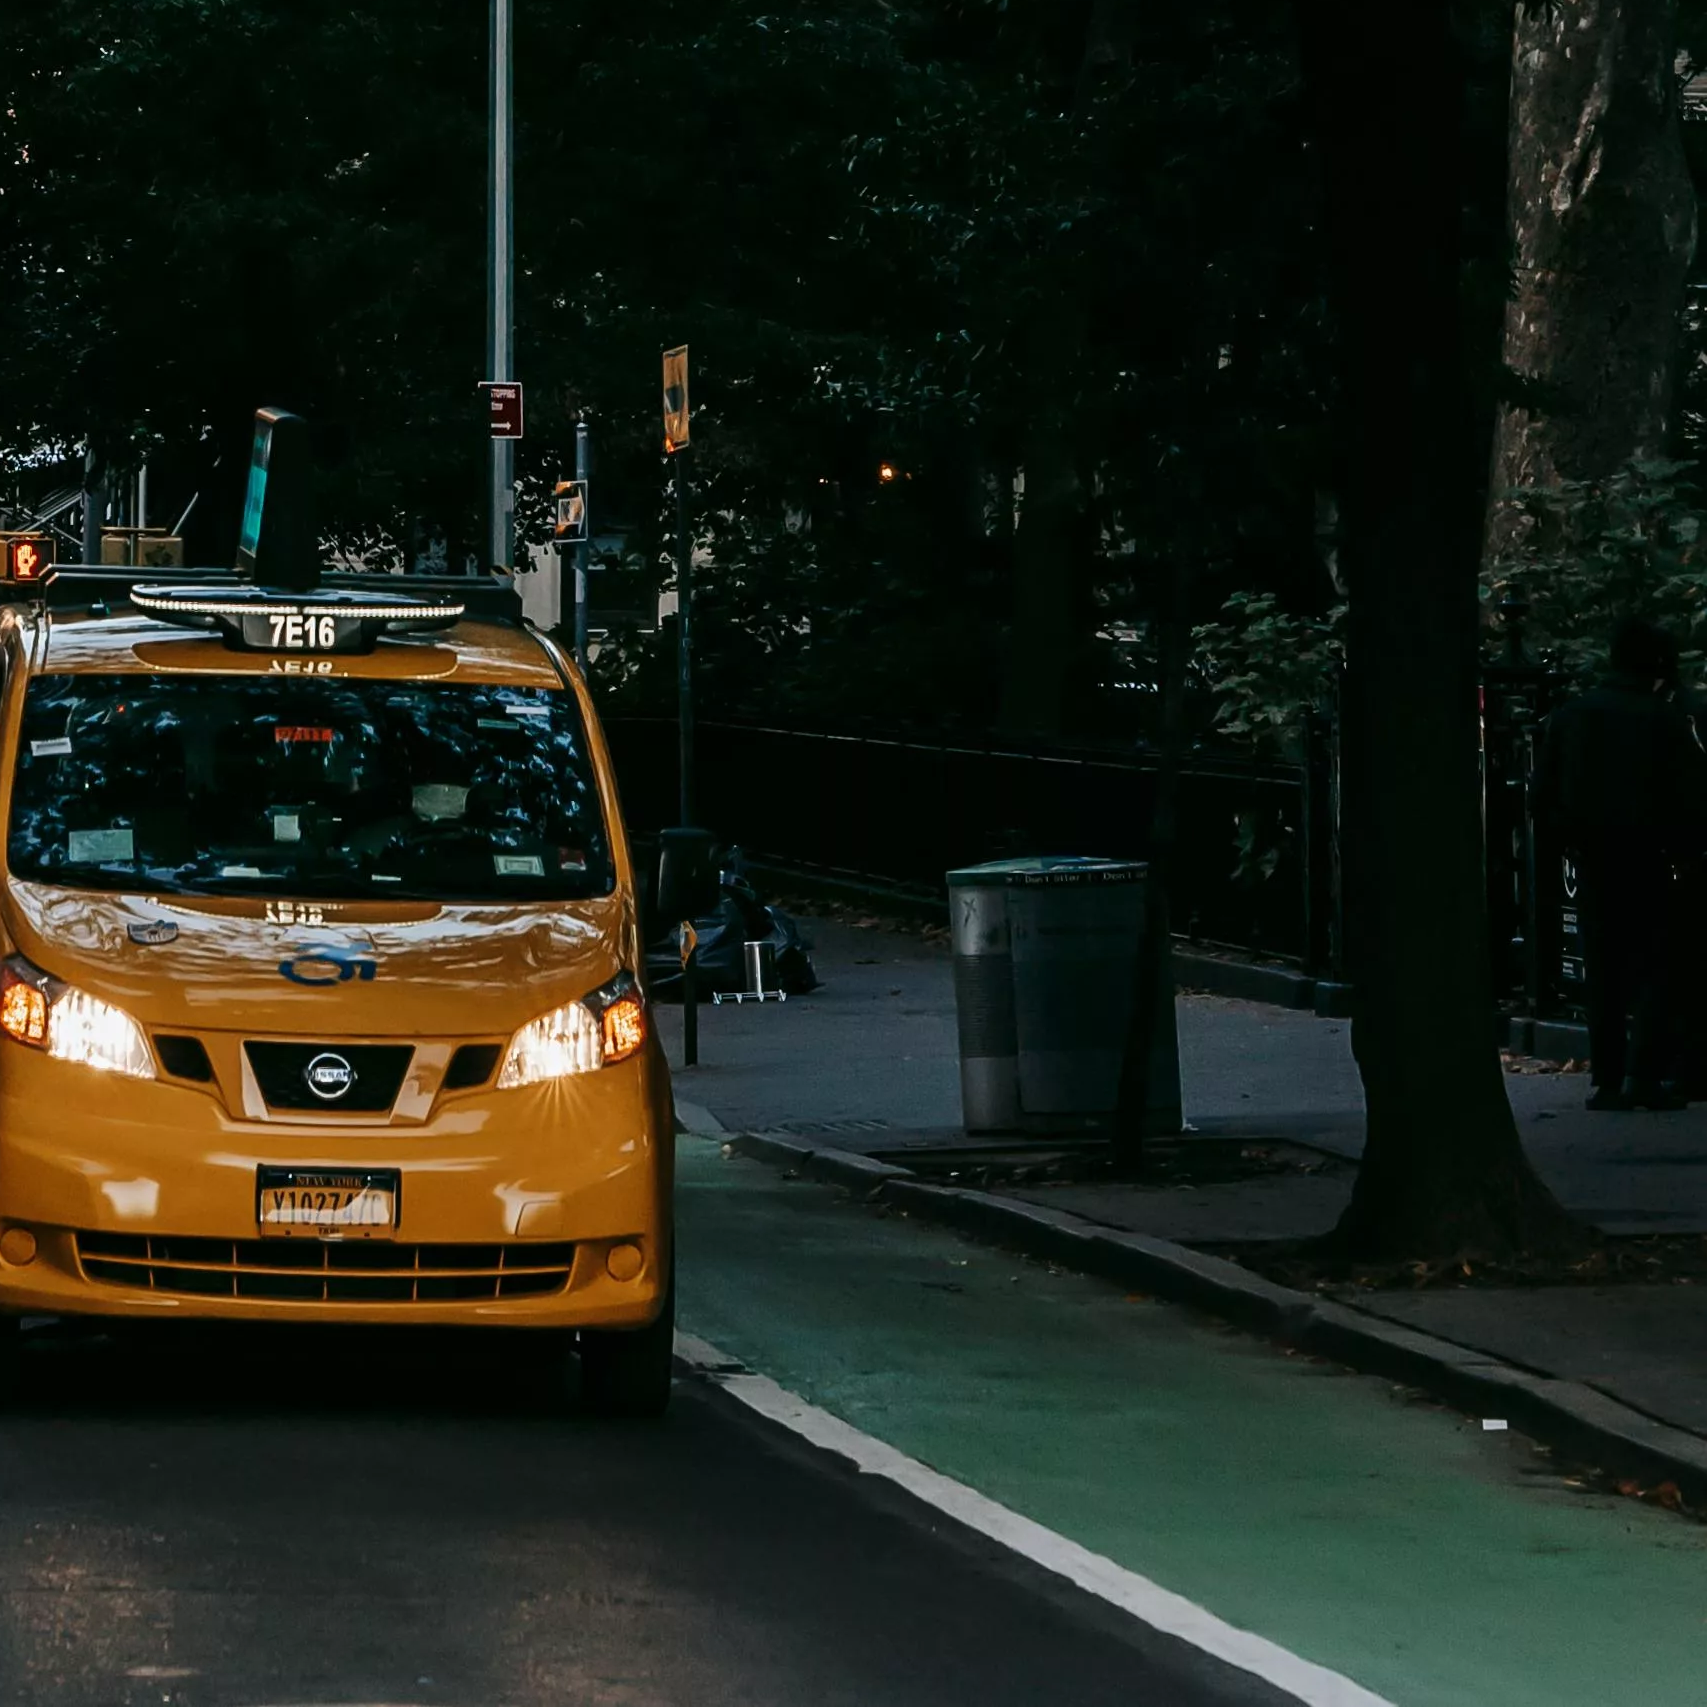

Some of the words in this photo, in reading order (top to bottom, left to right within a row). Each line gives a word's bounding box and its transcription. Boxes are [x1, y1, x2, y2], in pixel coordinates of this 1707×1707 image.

[269, 614, 335, 648] 7E16
[296, 1177, 327, 1186] NEW
[332, 1177, 362, 1187] YORK
